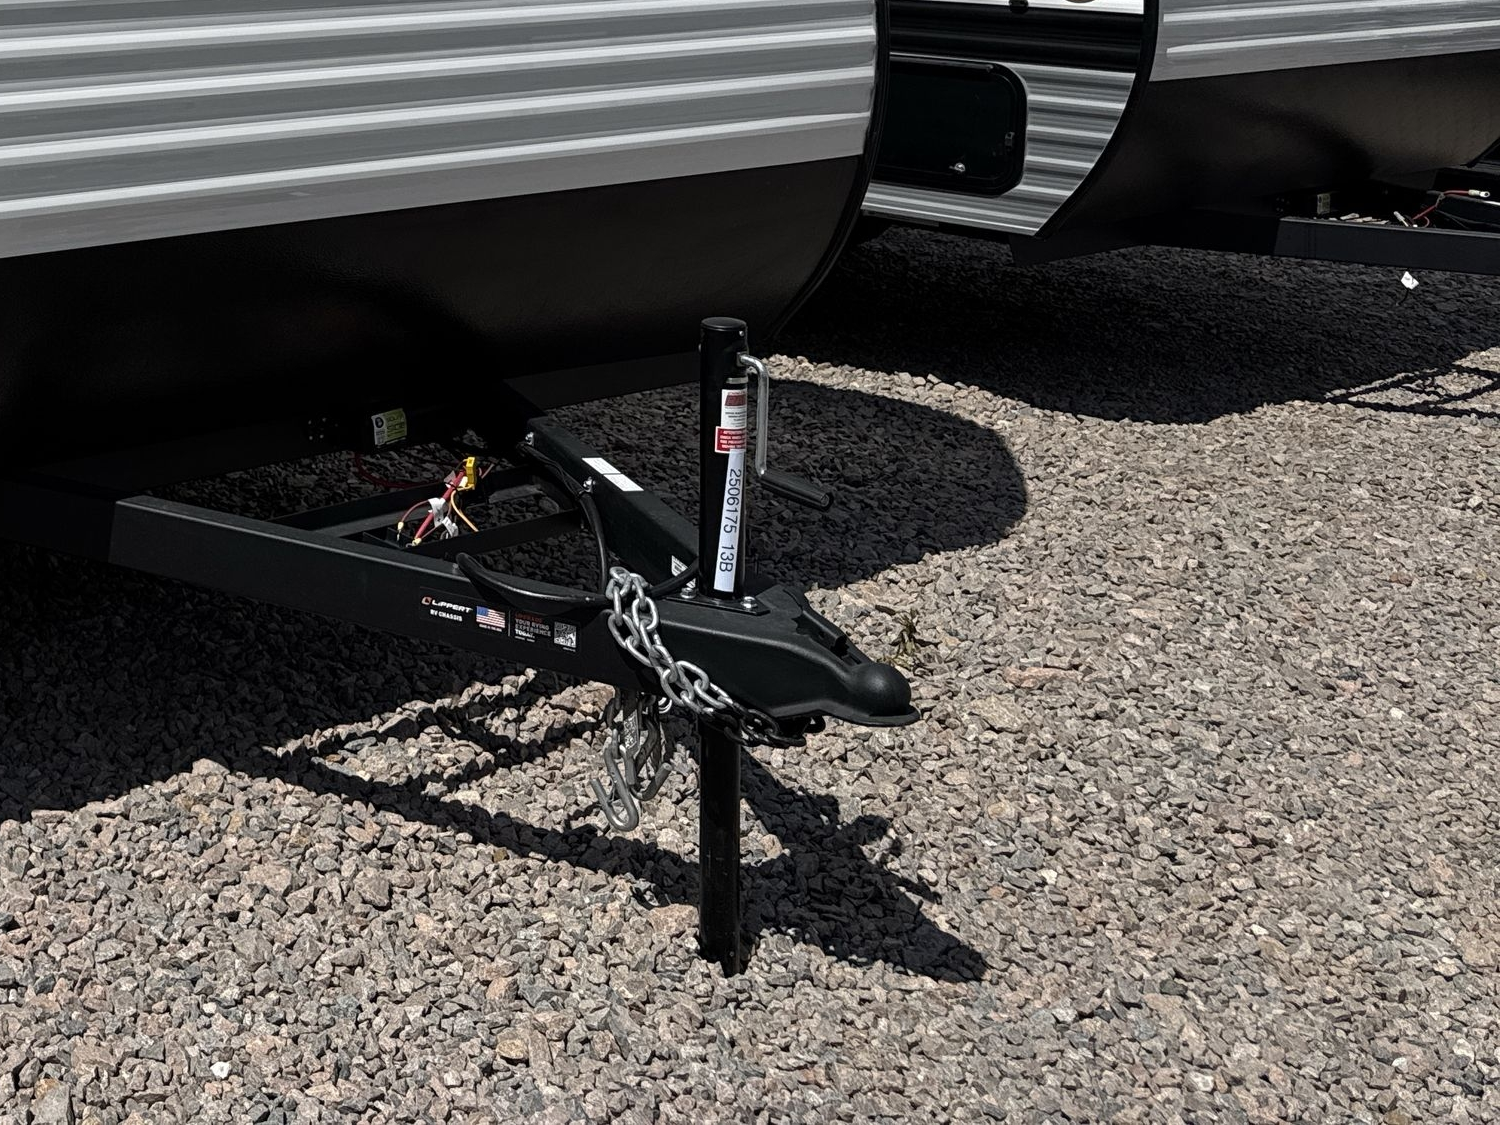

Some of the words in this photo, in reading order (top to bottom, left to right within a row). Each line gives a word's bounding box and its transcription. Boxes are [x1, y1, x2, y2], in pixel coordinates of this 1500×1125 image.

[723, 468, 742, 534] 2506175
[719, 544, 735, 573] 13B
[431, 599, 473, 614] LIPPERT
